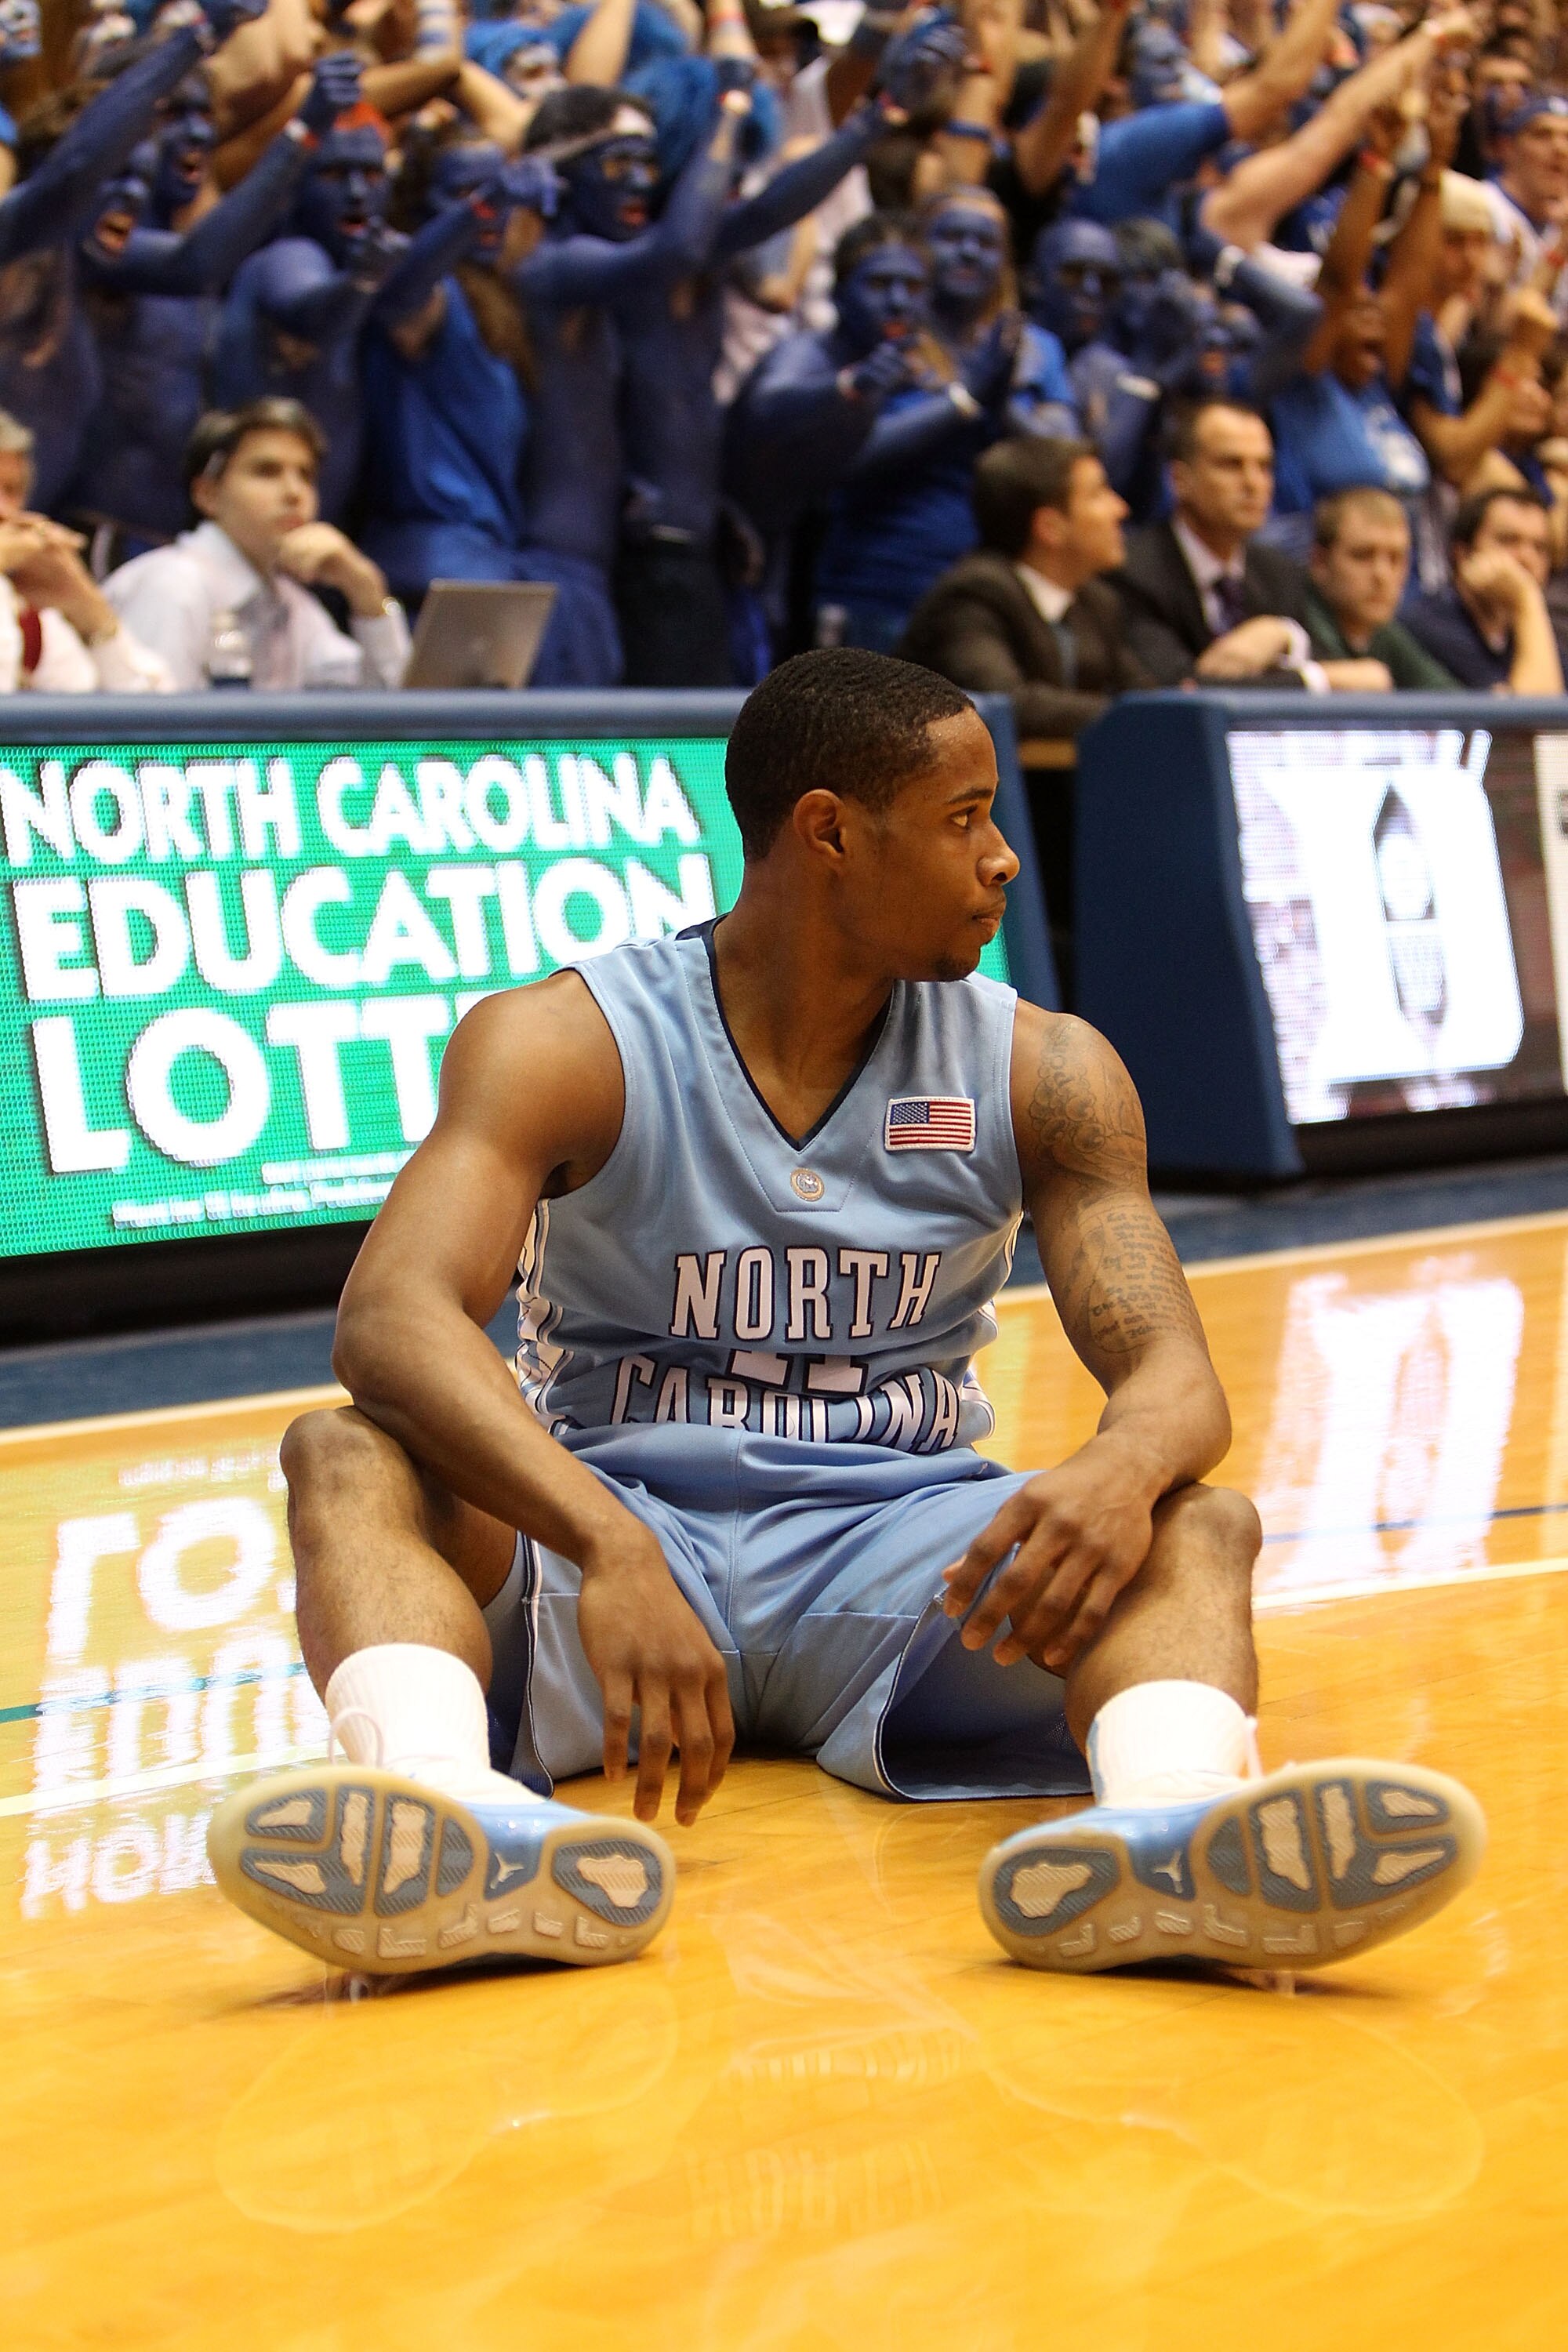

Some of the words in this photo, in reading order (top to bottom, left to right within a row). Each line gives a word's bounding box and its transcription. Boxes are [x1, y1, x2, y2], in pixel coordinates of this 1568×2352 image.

[0, 758, 303, 868] NORTH
[316, 755, 703, 858] CAROLINA
[12, 853, 717, 1003] EDUCATION
[31, 990, 502, 1175] LOTT
[668, 1245, 942, 1341] NORTH
